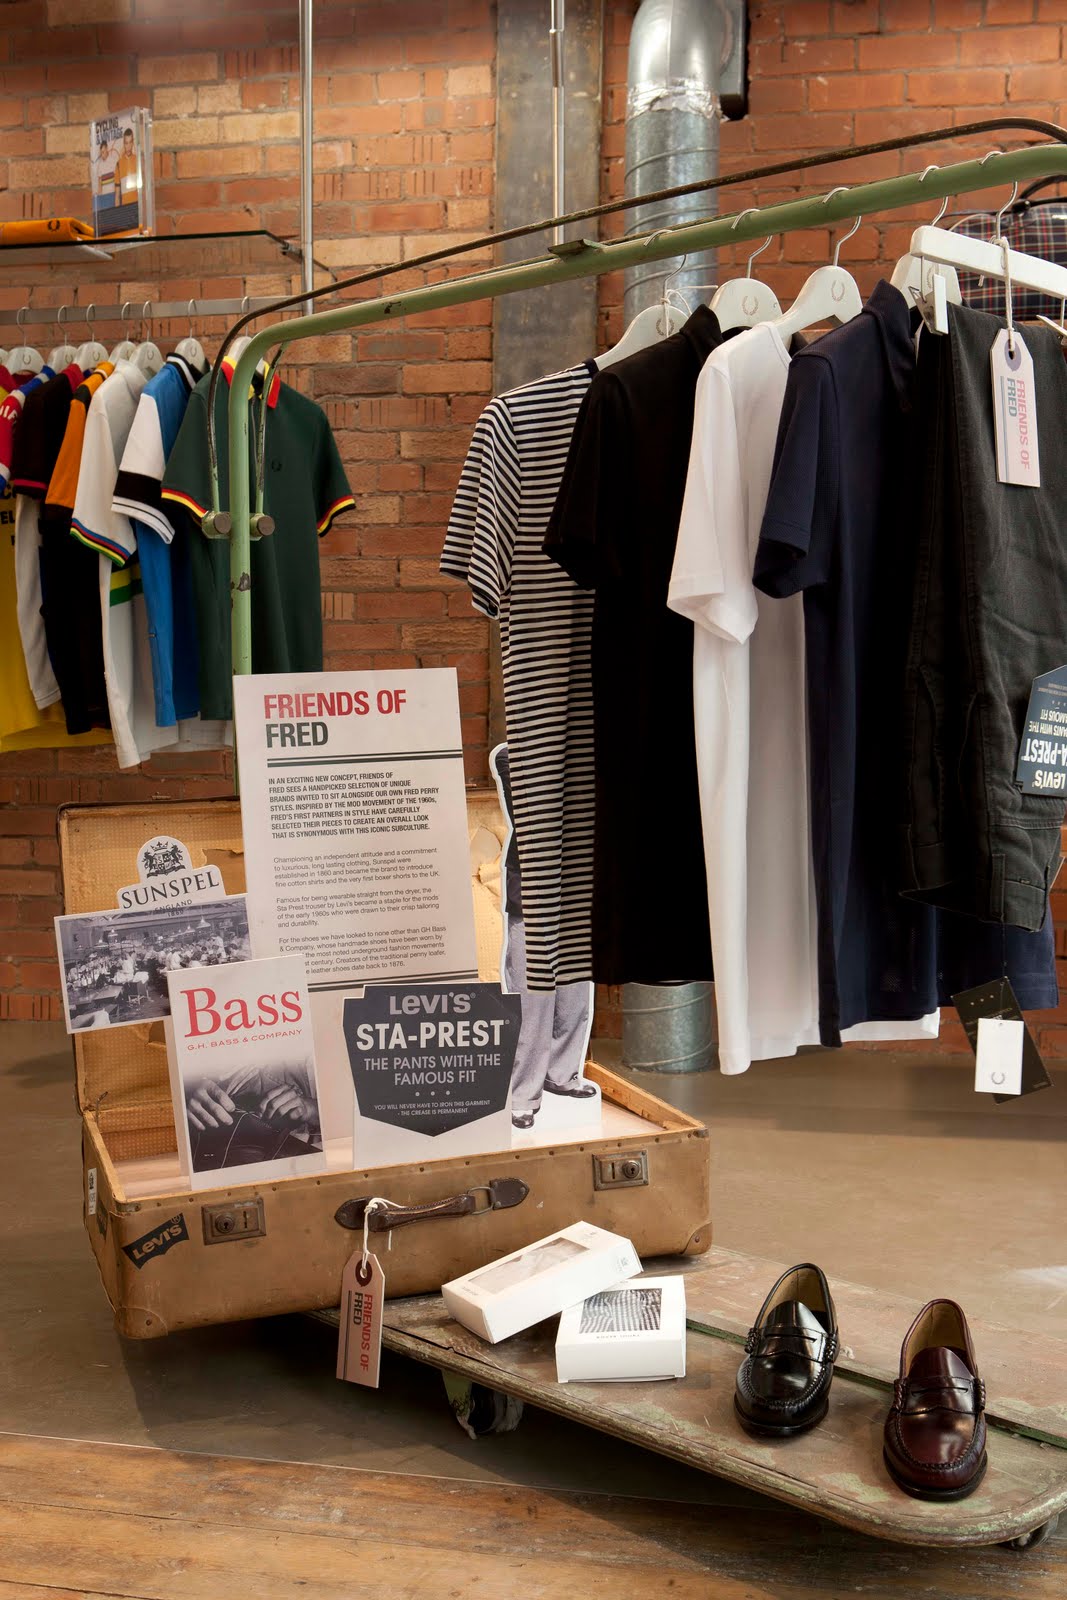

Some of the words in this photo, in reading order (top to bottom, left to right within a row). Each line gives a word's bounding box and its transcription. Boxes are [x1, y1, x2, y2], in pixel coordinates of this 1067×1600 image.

[1007, 378, 1017, 417] FRED
[1017, 379, 1028, 446] FRIENDS
[1021, 450, 1030, 469] OF
[264, 691, 369, 719] FRIENDS
[376, 690, 406, 714] OF
[1048, 711, 1067, 724] AMOUS
[1029, 721, 1039, 732] THE
[266, 722, 328, 748] FRED
[359, 772, 384, 780] FRIENDS
[308, 783, 346, 791] HANDPICKED
[341, 791, 374, 799] ALONGSIDE
[362, 799, 395, 807] MOVEMENT
[388, 806, 420, 814] CAREFULLY
[272, 822, 301, 830] SELECTED
[296, 829, 338, 837] SYNONYMOUS
[391, 824, 429, 832] SUBCULTURE.
[274, 855, 313, 863] Championing
[323, 852, 360, 860] independent
[121, 872, 219, 909] SUNSPEL
[180, 988, 302, 1038] Bass
[211, 1038, 239, 1047] BASS
[251, 1029, 302, 1041] COMPANY
[356, 1020, 504, 1050] STA-PREST
[364, 1058, 388, 1070] THE
[393, 1056, 436, 1069] PANTS
[440, 1055, 473, 1067] WITH
[478, 1054, 500, 1066] THE
[394, 1071, 454, 1086] FAMOUS
[459, 1070, 476, 1082] FIT
[353, 1292, 363, 1325] FRED
[361, 1293, 373, 1351] FRIENDS
[360, 1354, 369, 1371] OF
